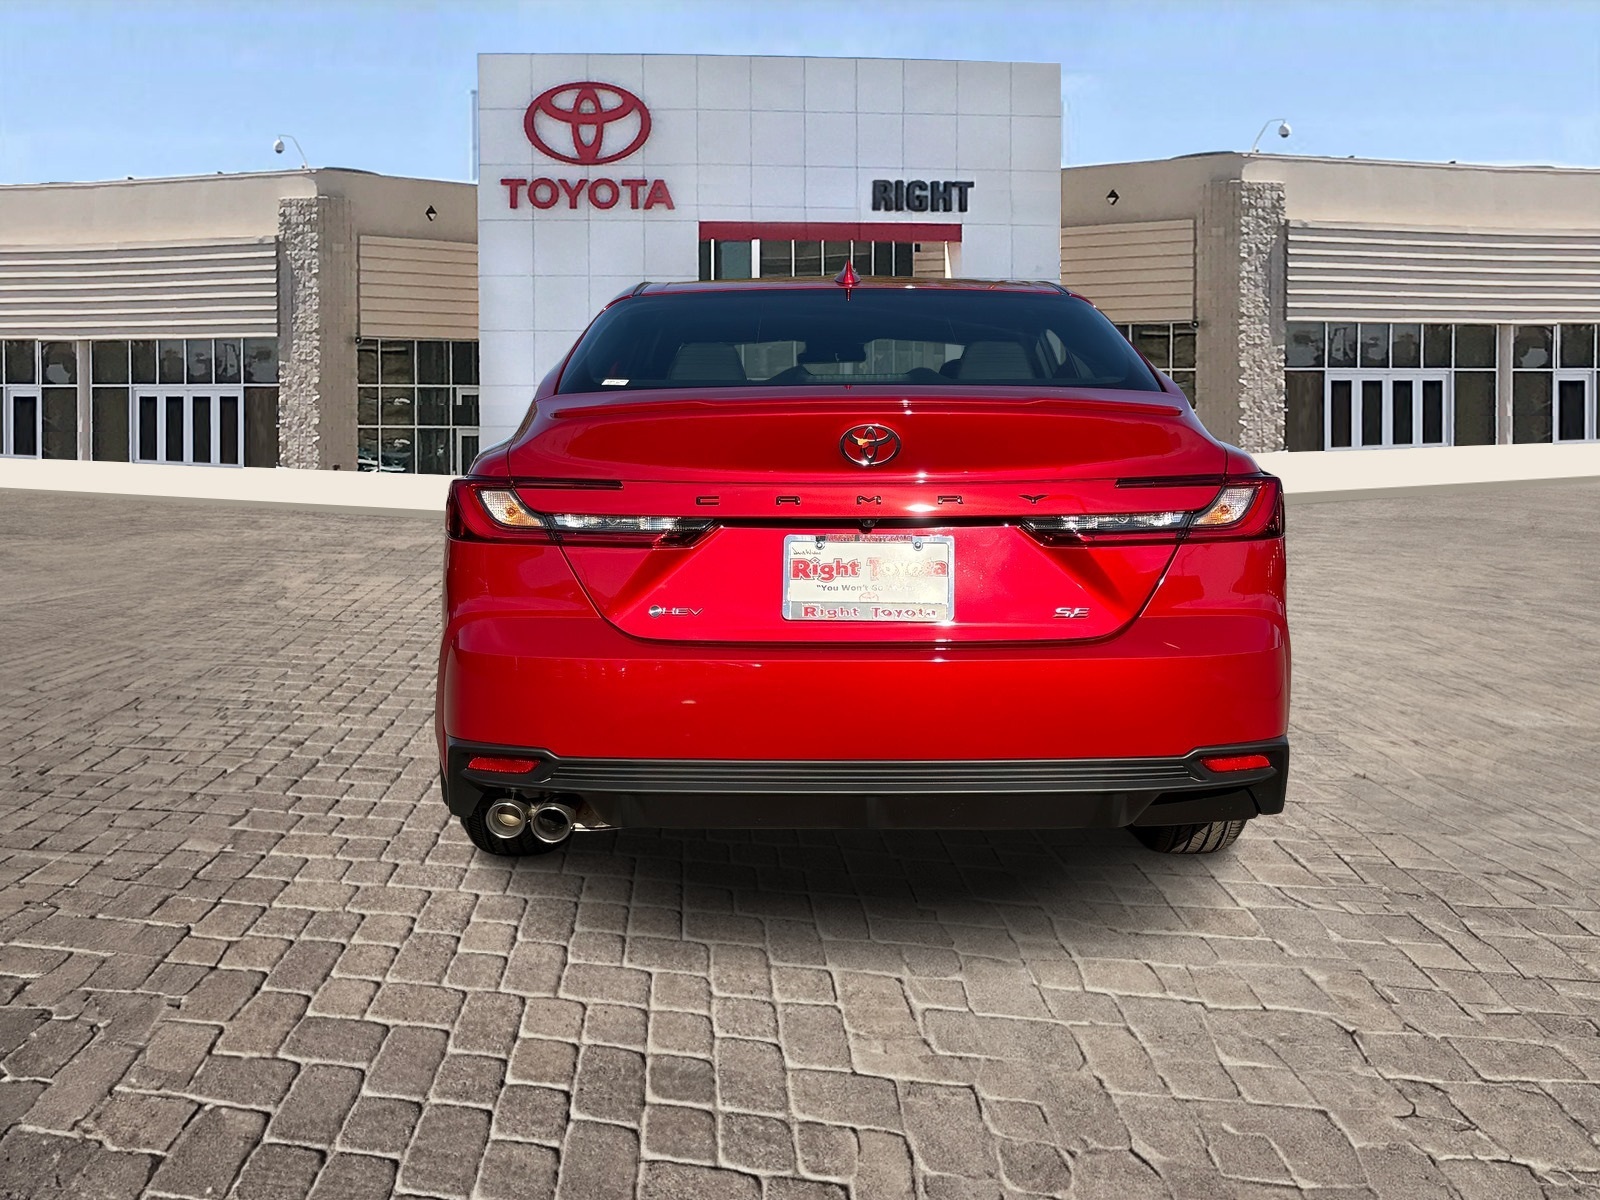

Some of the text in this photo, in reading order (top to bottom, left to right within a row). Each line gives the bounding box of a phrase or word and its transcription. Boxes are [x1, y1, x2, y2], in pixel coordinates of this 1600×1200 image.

[500, 178, 675, 210] TOYOTA
[871, 179, 975, 212] RIGHT
[695, 494, 1049, 506] CAMRY
[790, 557, 949, 582] Right Toyota
[661, 606, 703, 616] HEV
[802, 605, 938, 619] Right Toyota
[1053, 606, 1090, 619] SE
